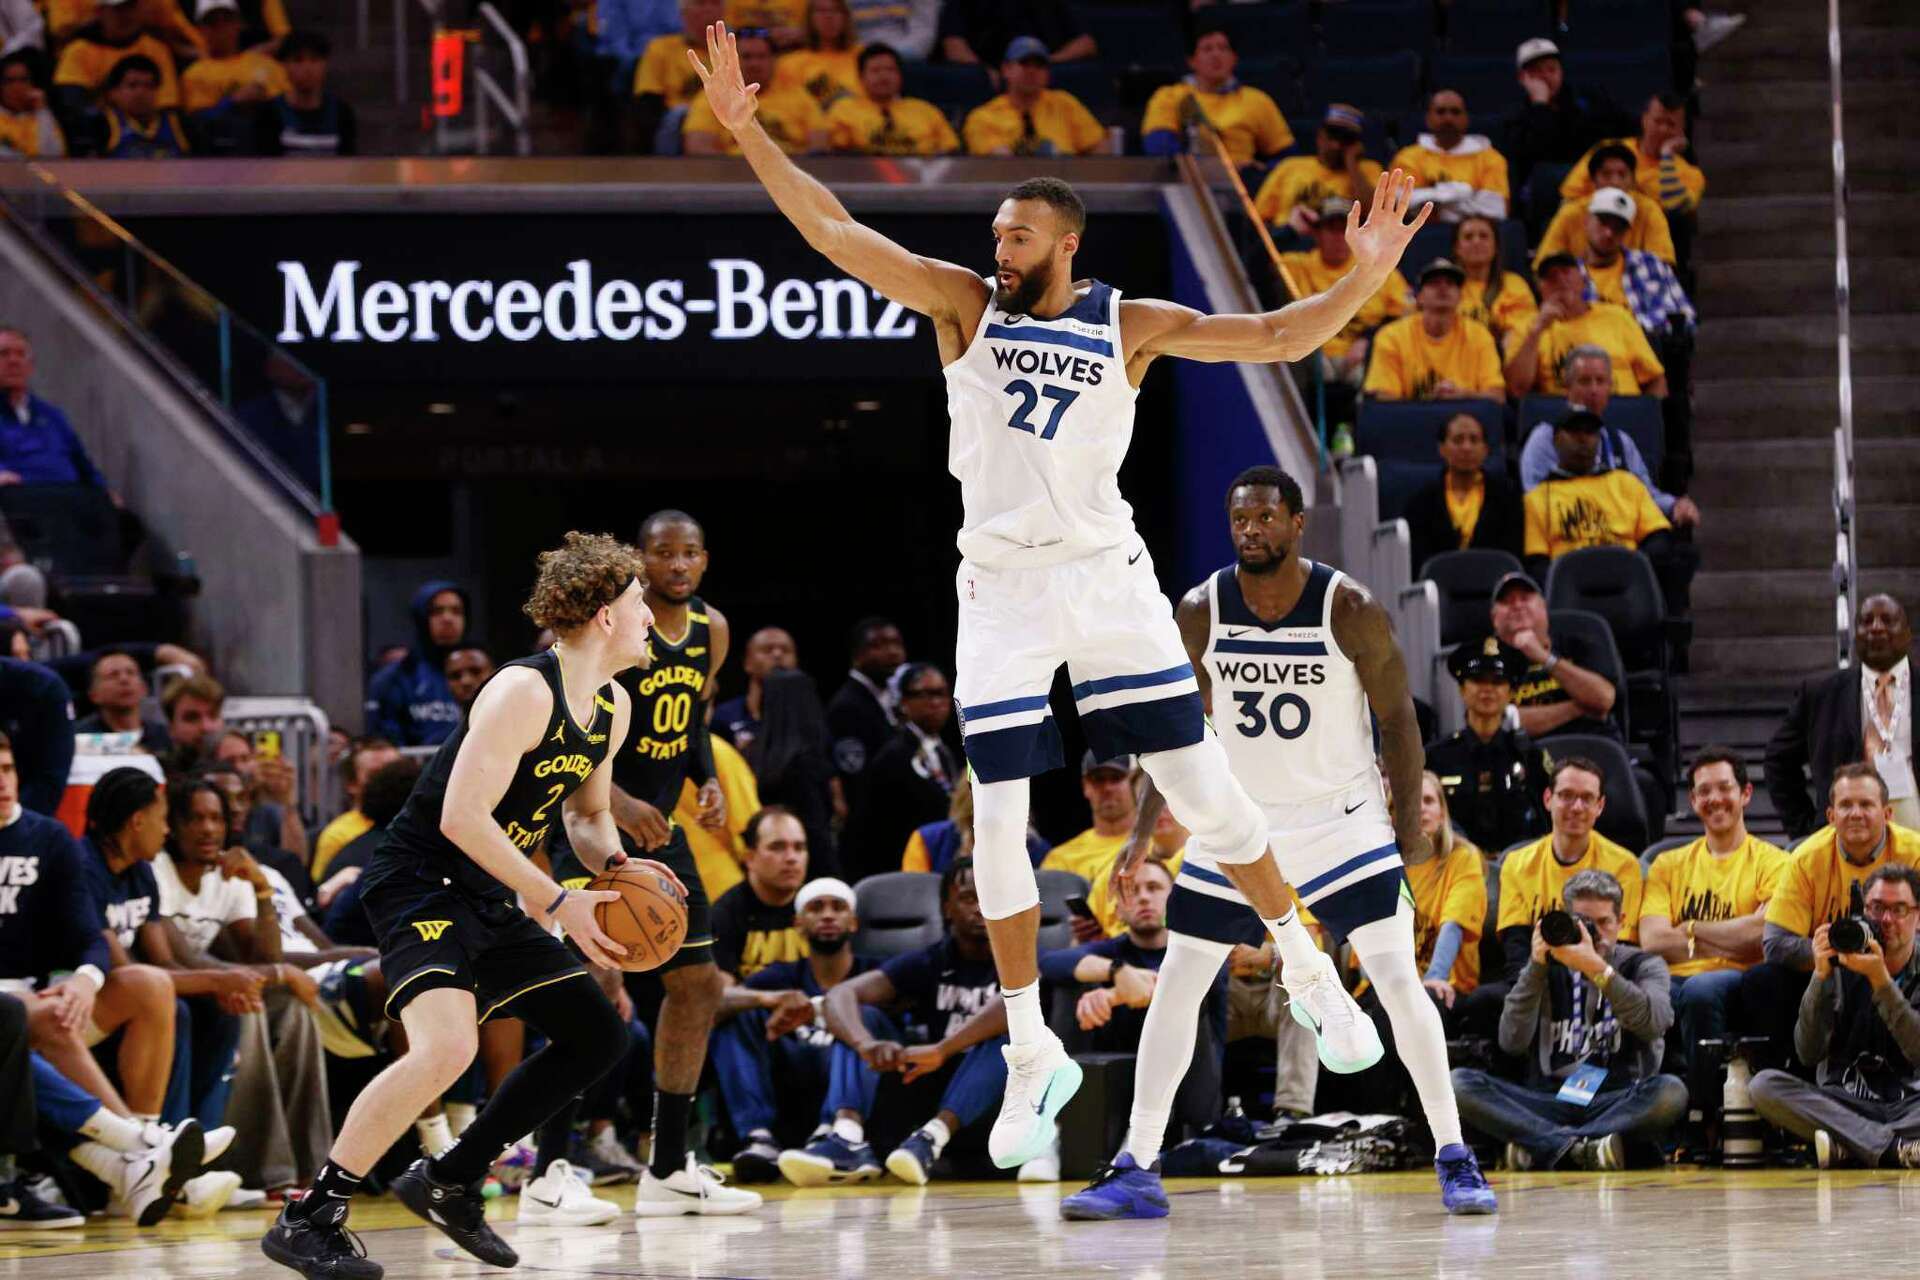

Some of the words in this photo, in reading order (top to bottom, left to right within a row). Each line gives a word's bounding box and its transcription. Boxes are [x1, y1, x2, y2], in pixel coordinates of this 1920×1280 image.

[277, 259, 917, 342] Mercedes-Benz
[991, 346, 1105, 386] WOLVES
[1003, 379, 1081, 440] 27
[639, 665, 706, 696] GOLDEN
[1216, 660, 1326, 685] WOLVES
[653, 692, 692, 734] 00
[1232, 690, 1312, 740] 30
[636, 734, 689, 760] STATE
[534, 754, 595, 783] GOLDEN
[531, 783, 566, 821] 2
